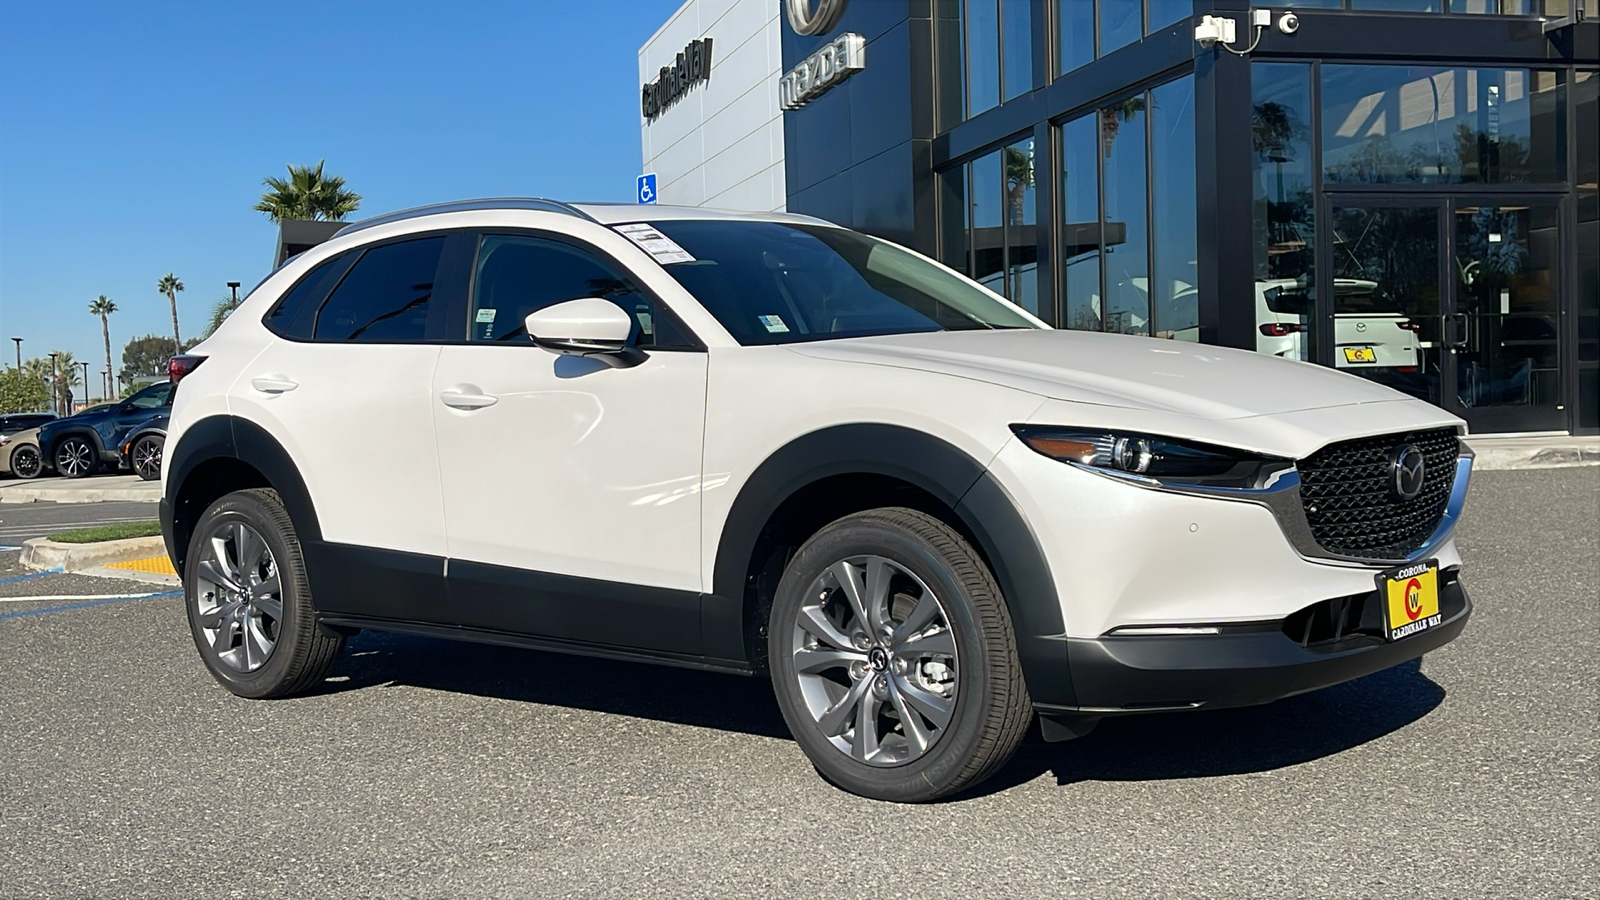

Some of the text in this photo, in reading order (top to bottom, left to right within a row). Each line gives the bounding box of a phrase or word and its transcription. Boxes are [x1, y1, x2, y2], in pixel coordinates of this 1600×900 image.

[1398, 563, 1427, 579] CORONA
[1392, 614, 1442, 640] CARDINALE WAY
